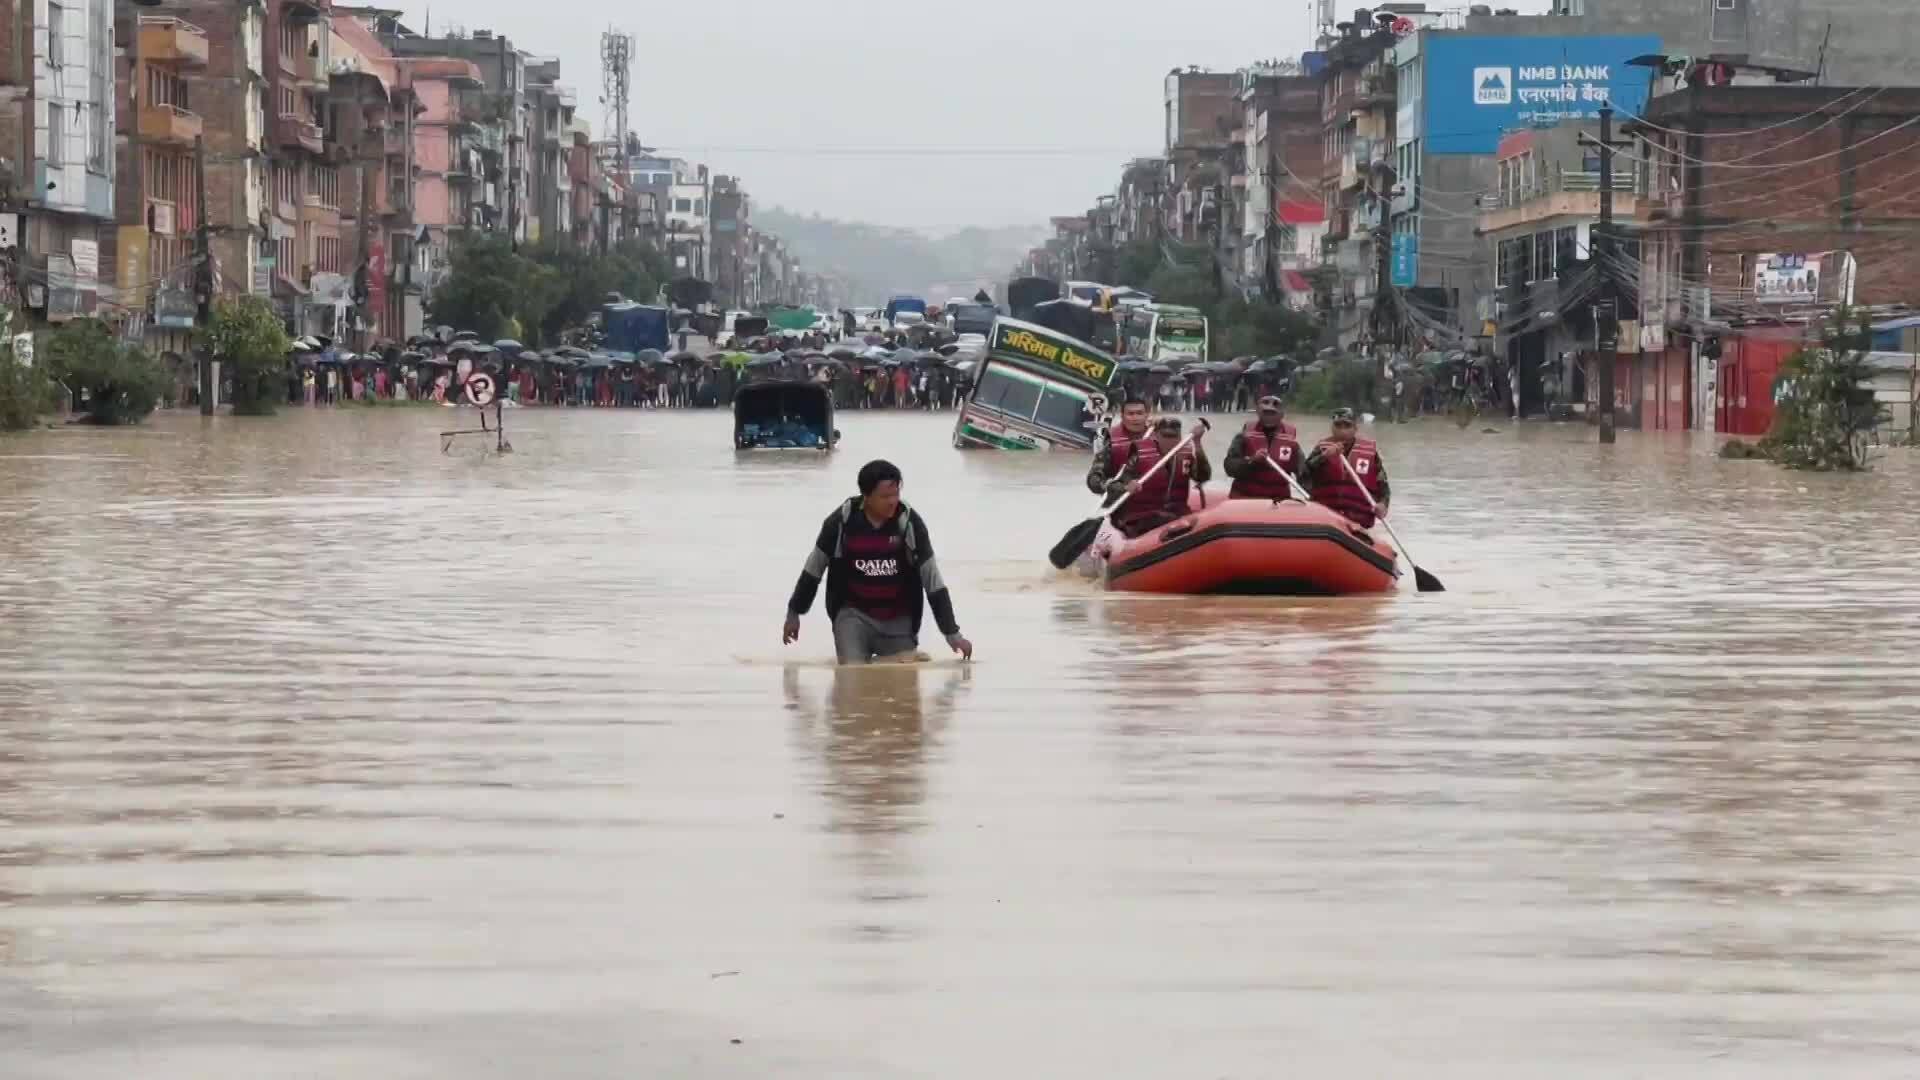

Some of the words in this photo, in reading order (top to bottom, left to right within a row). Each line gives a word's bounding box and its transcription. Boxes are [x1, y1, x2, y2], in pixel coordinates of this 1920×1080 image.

[1519, 66, 1556, 80] NMB
[1561, 65, 1609, 80] BANK
[855, 559, 896, 572] QATAR
